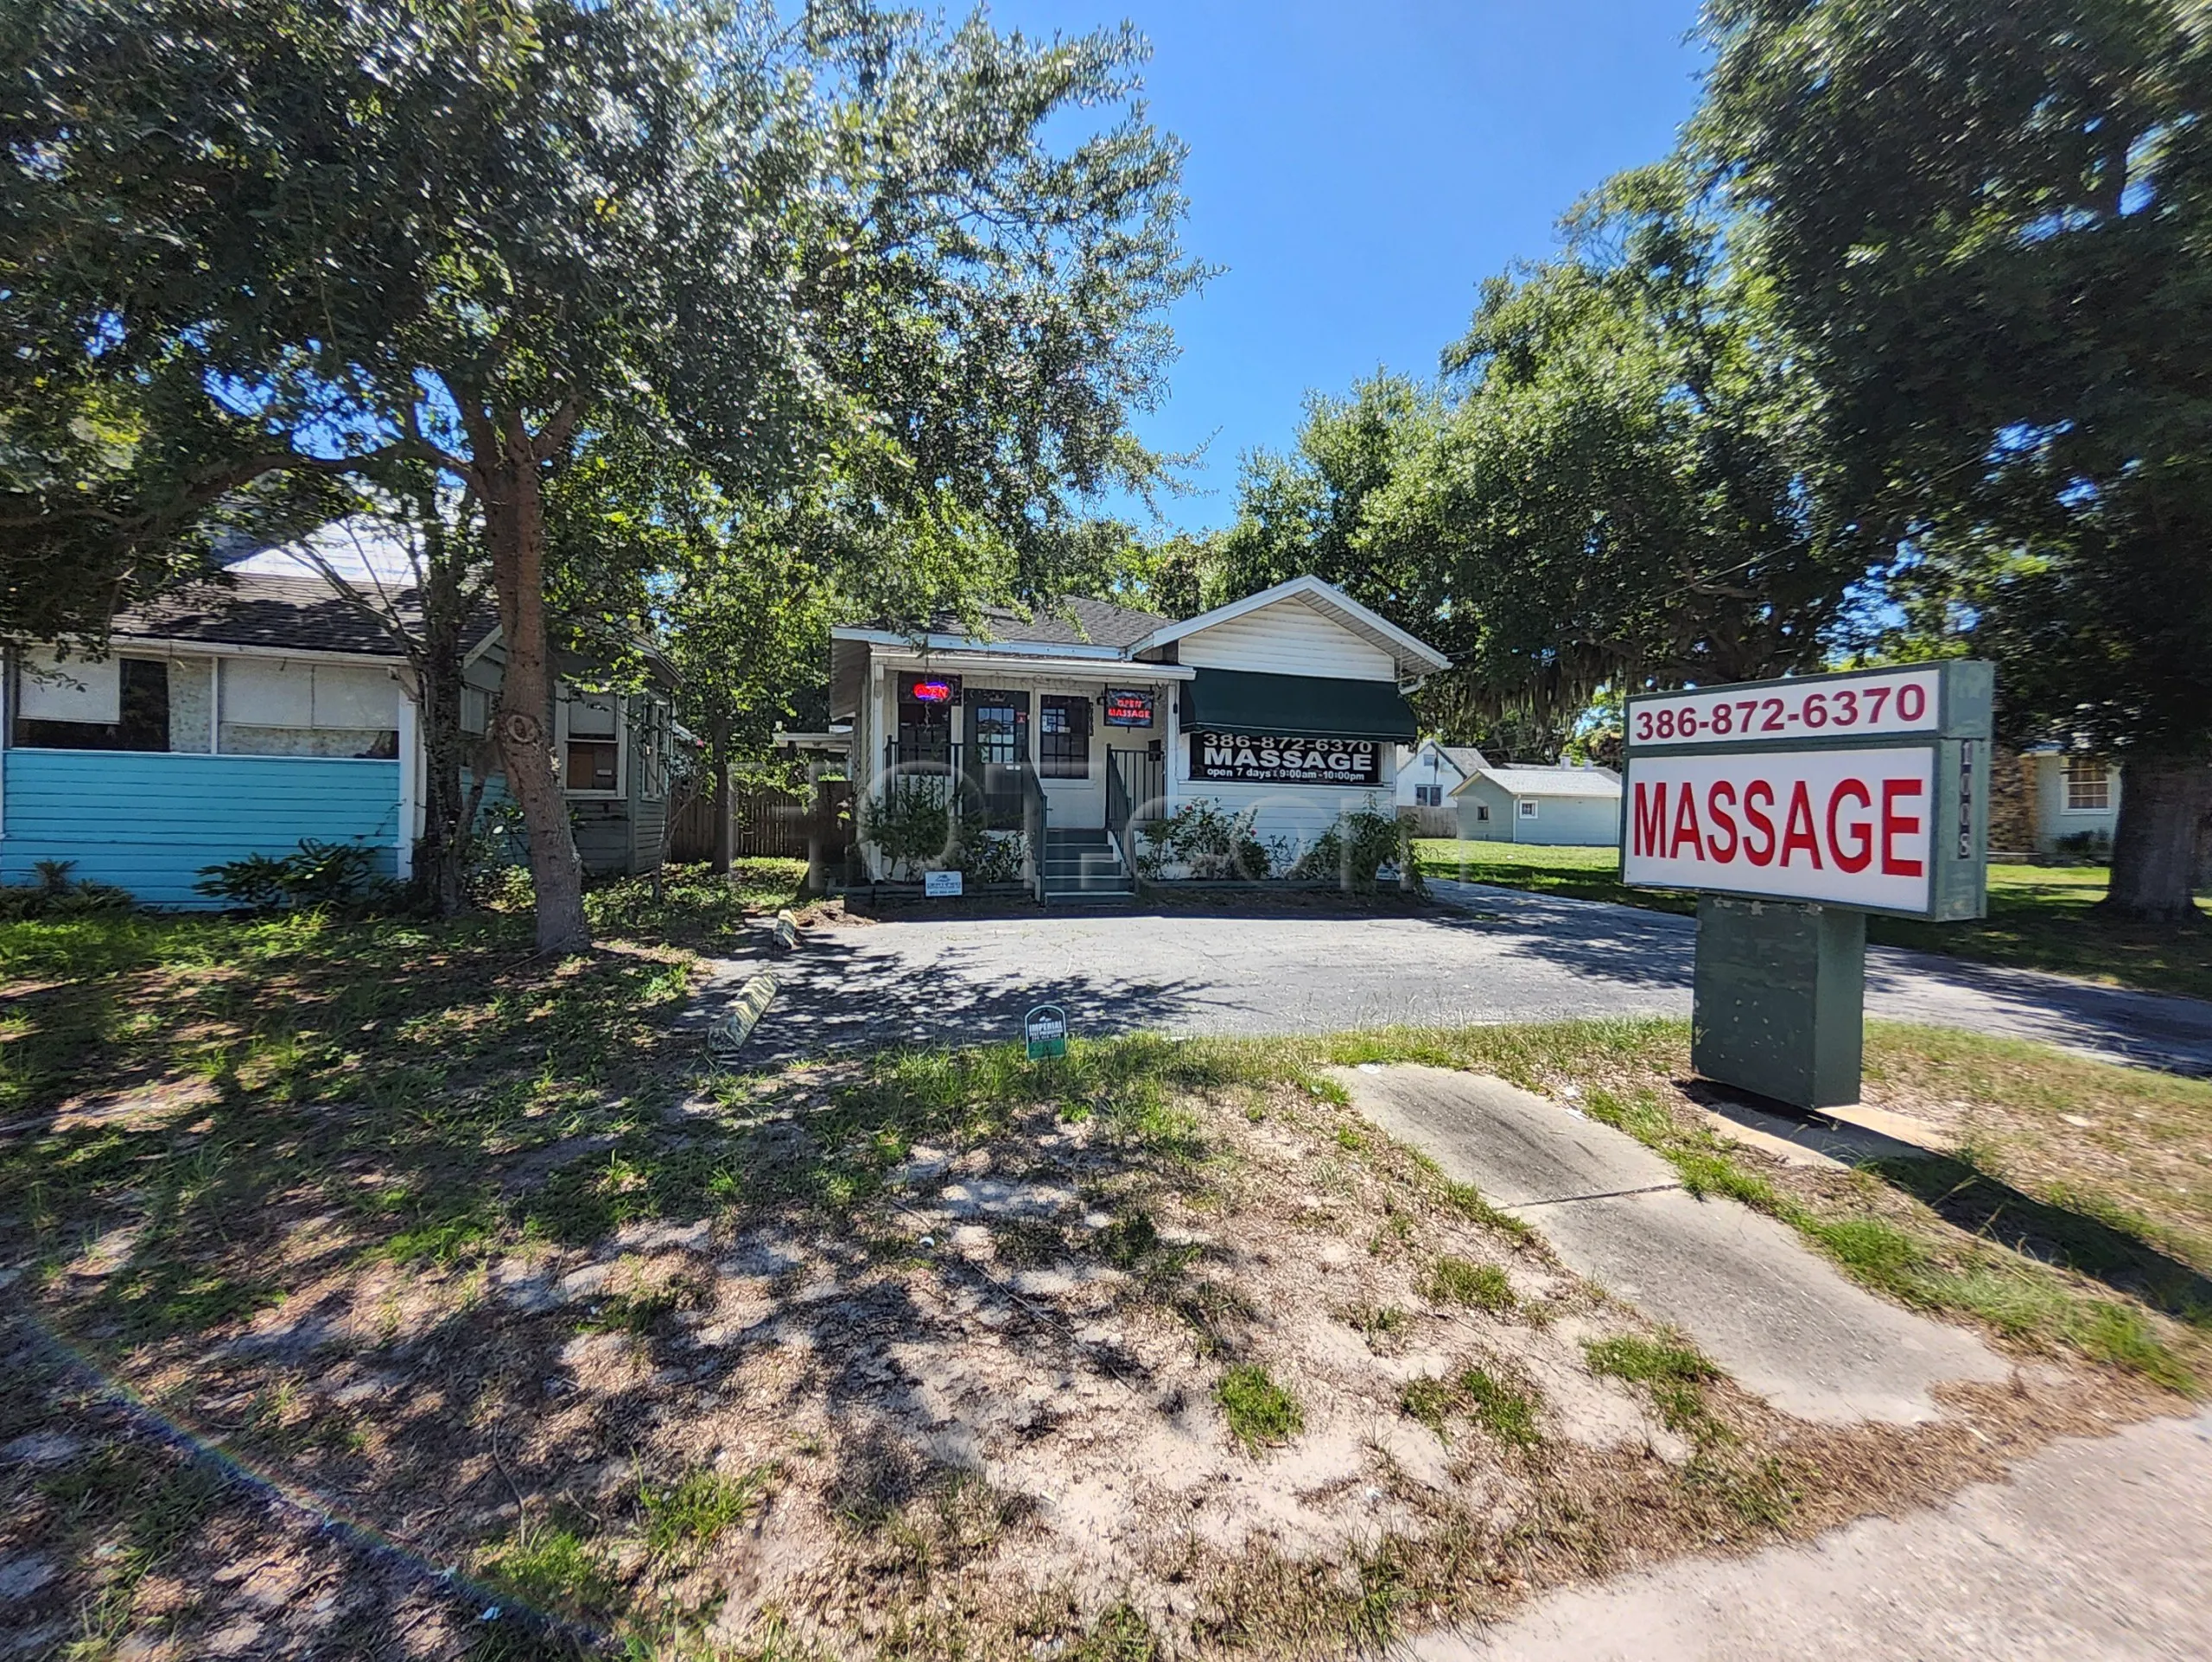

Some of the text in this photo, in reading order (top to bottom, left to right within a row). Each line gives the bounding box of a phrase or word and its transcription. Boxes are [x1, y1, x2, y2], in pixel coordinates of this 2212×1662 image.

[1117, 699, 1142, 708] OPEN
[1108, 708, 1151, 718] MASSAGE
[1635, 684, 1926, 741] 386-872-6370
[1203, 734, 1372, 753] 386-872-6370
[1204, 747, 1372, 771] MASSAGE
[1207, 768, 1233, 777] open
[1236, 767, 1243, 776] 7
[1246, 768, 1271, 779] days
[1633, 779, 1923, 877] MASSAGE
[1029, 1021, 1063, 1032] IMPERIAL
